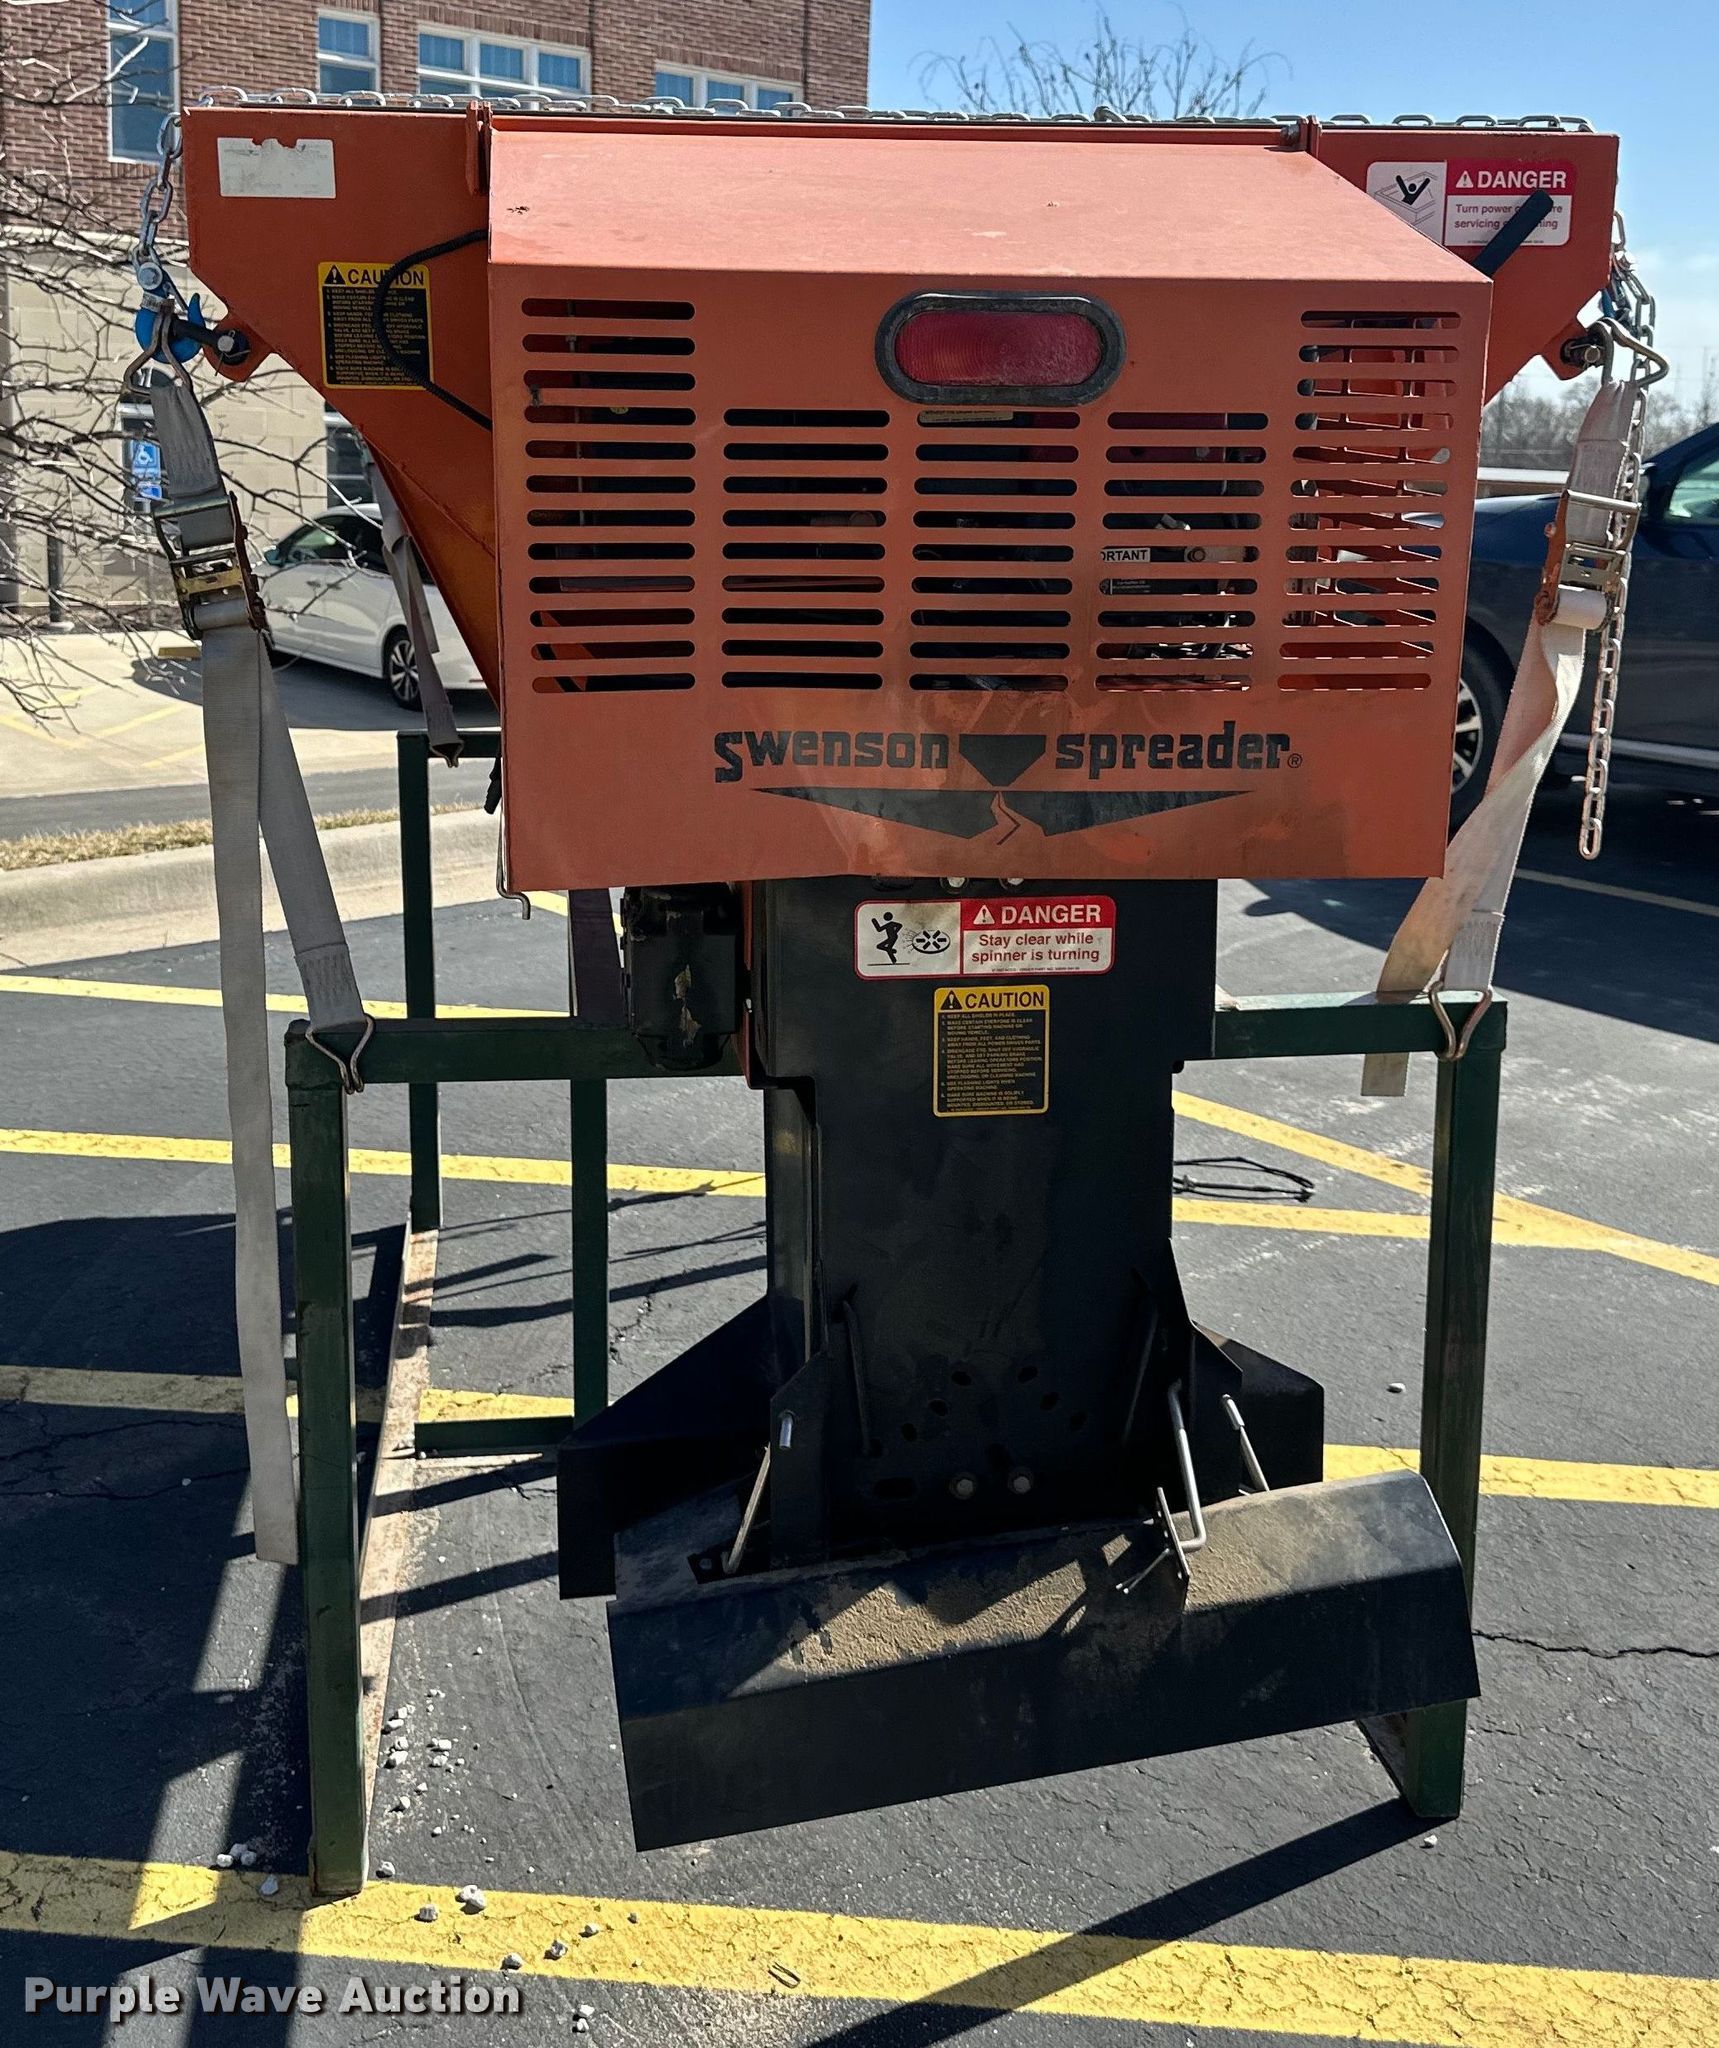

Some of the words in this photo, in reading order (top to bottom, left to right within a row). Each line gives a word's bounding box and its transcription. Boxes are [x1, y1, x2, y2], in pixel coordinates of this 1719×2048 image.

[1477, 170, 1566, 189] DANGER
[1456, 203, 1478, 214] Turn
[1481, 205, 1513, 217] power
[1454, 218, 1500, 231] servicing
[347, 269, 424, 286] CAUON
[714, 731, 949, 783] Swenson
[1001, 904, 1101, 925] DANGER
[979, 933, 1011, 946] Stay
[1015, 933, 1052, 946] clear
[1055, 931, 1094, 944] while
[971, 949, 1026, 963] spinner
[1030, 949, 1044, 962] is
[1048, 949, 1100, 963] turning
[965, 991, 1044, 1009] CAUTION
